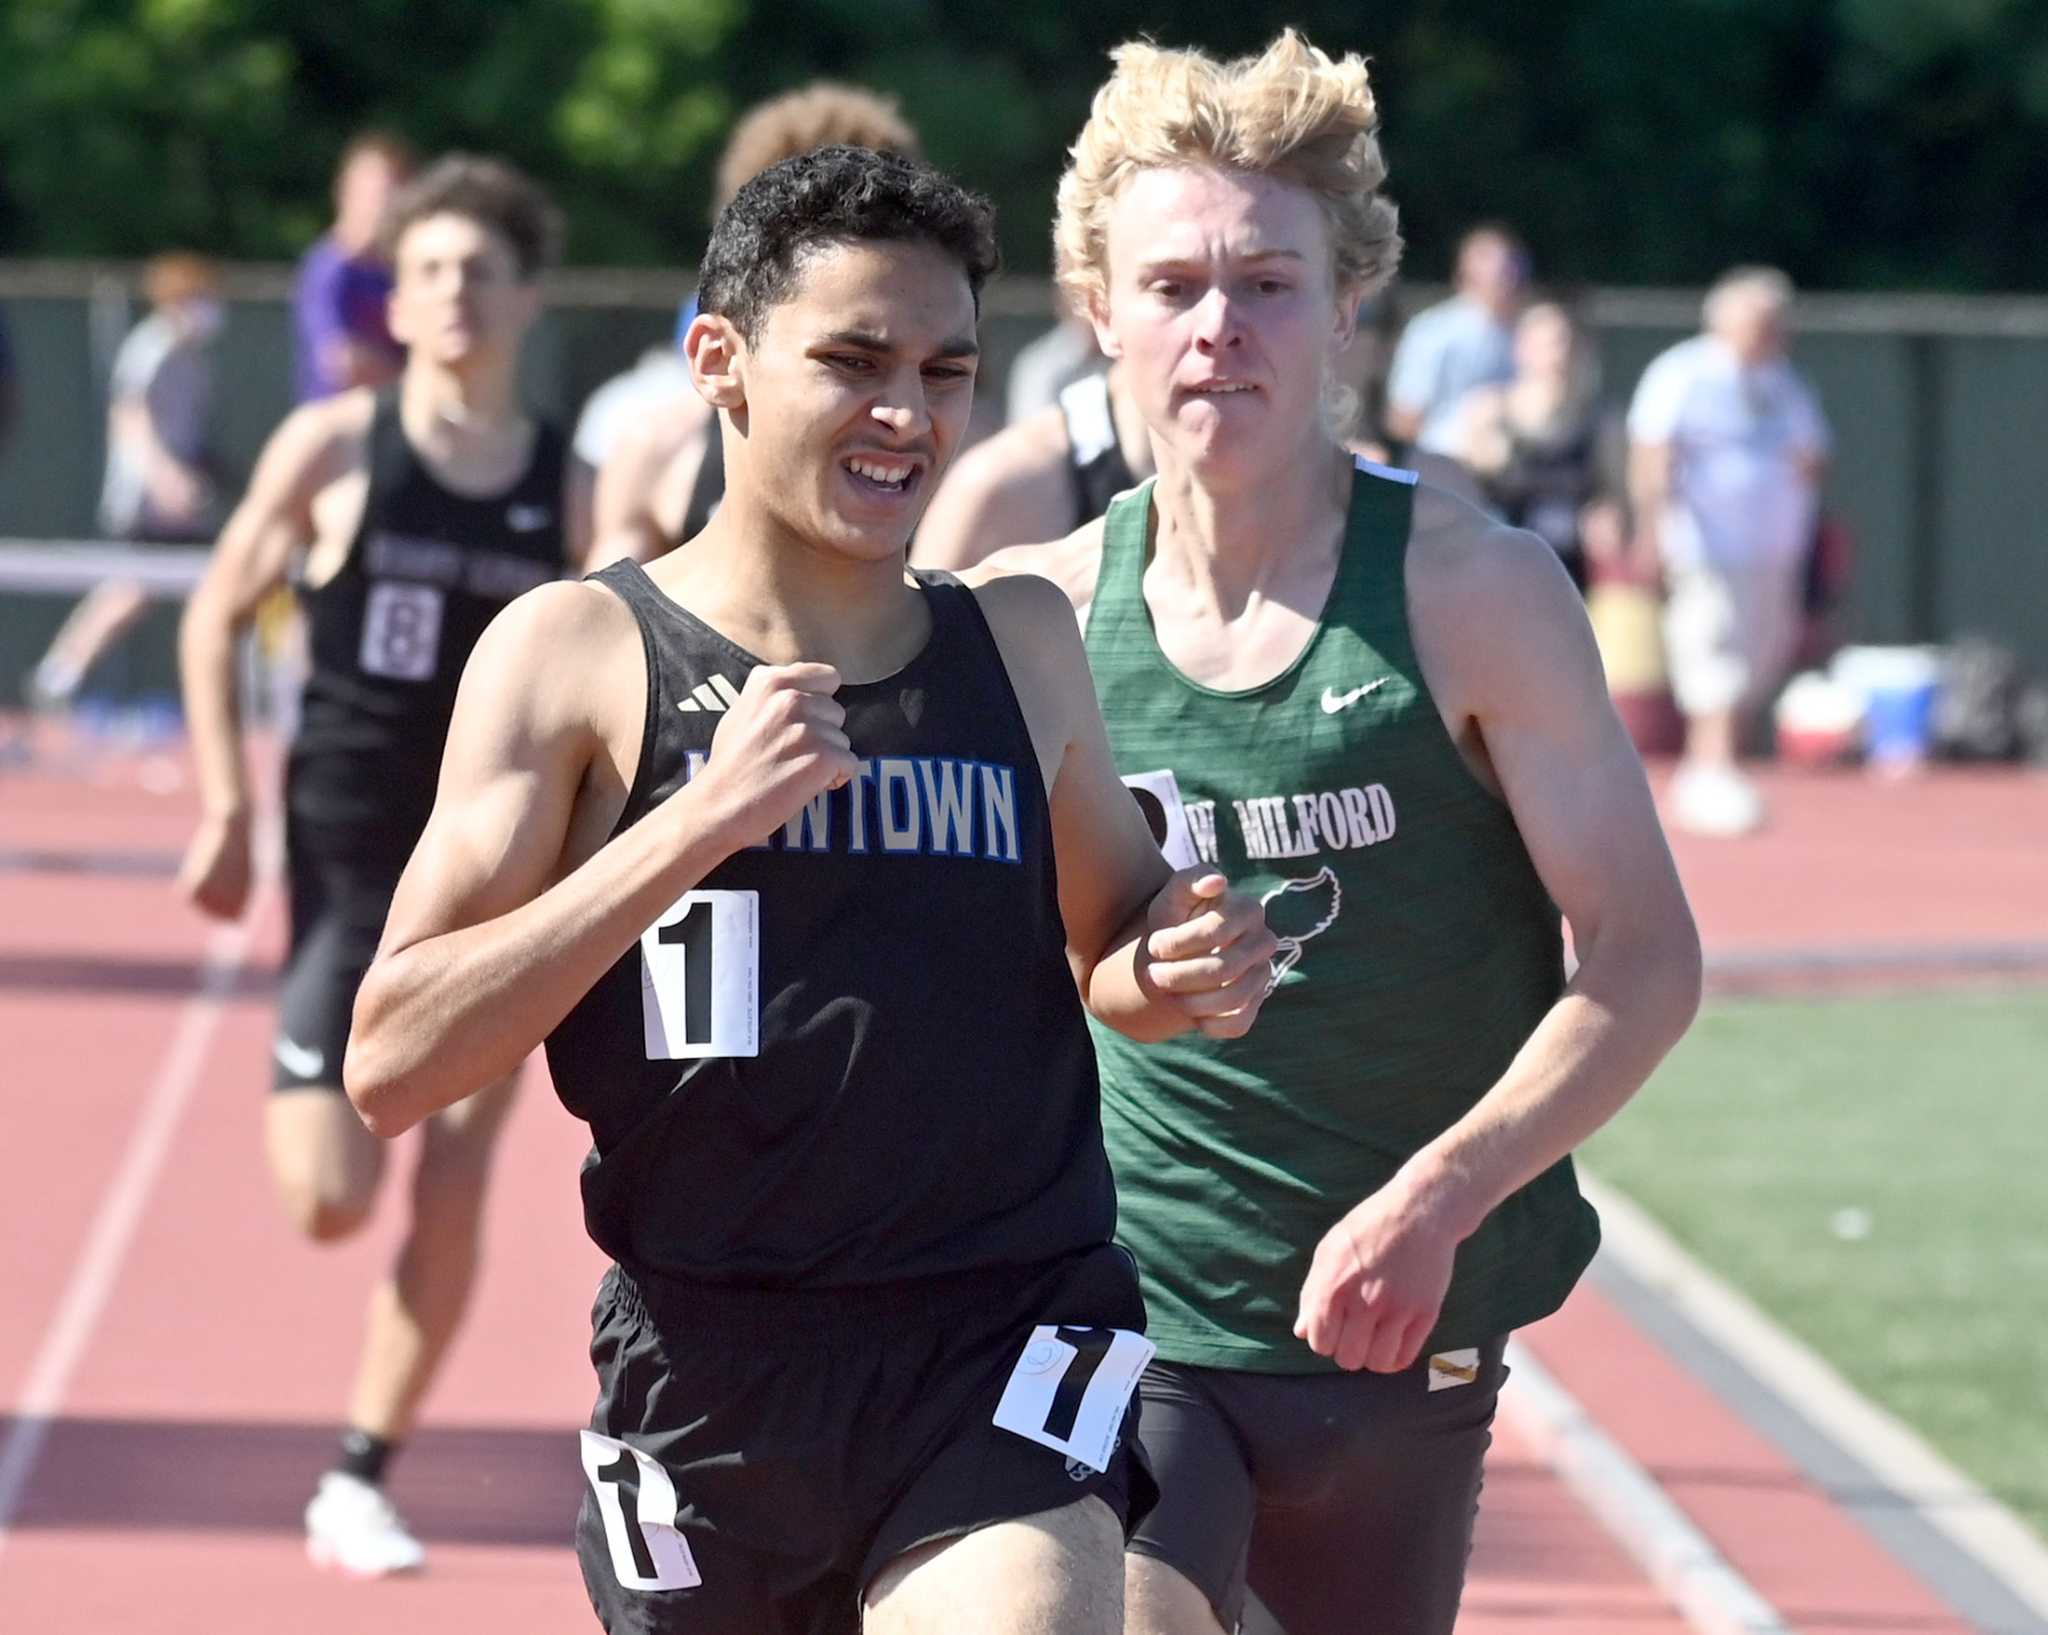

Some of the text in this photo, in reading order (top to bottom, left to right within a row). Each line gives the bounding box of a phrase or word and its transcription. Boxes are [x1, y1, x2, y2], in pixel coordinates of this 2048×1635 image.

[685, 748, 1022, 864] WTOWN
[1231, 782, 1398, 860] MILFORD
[658, 902, 713, 1044] 1
[1042, 1325, 1117, 1443] 1
[597, 1447, 659, 1580] 1
